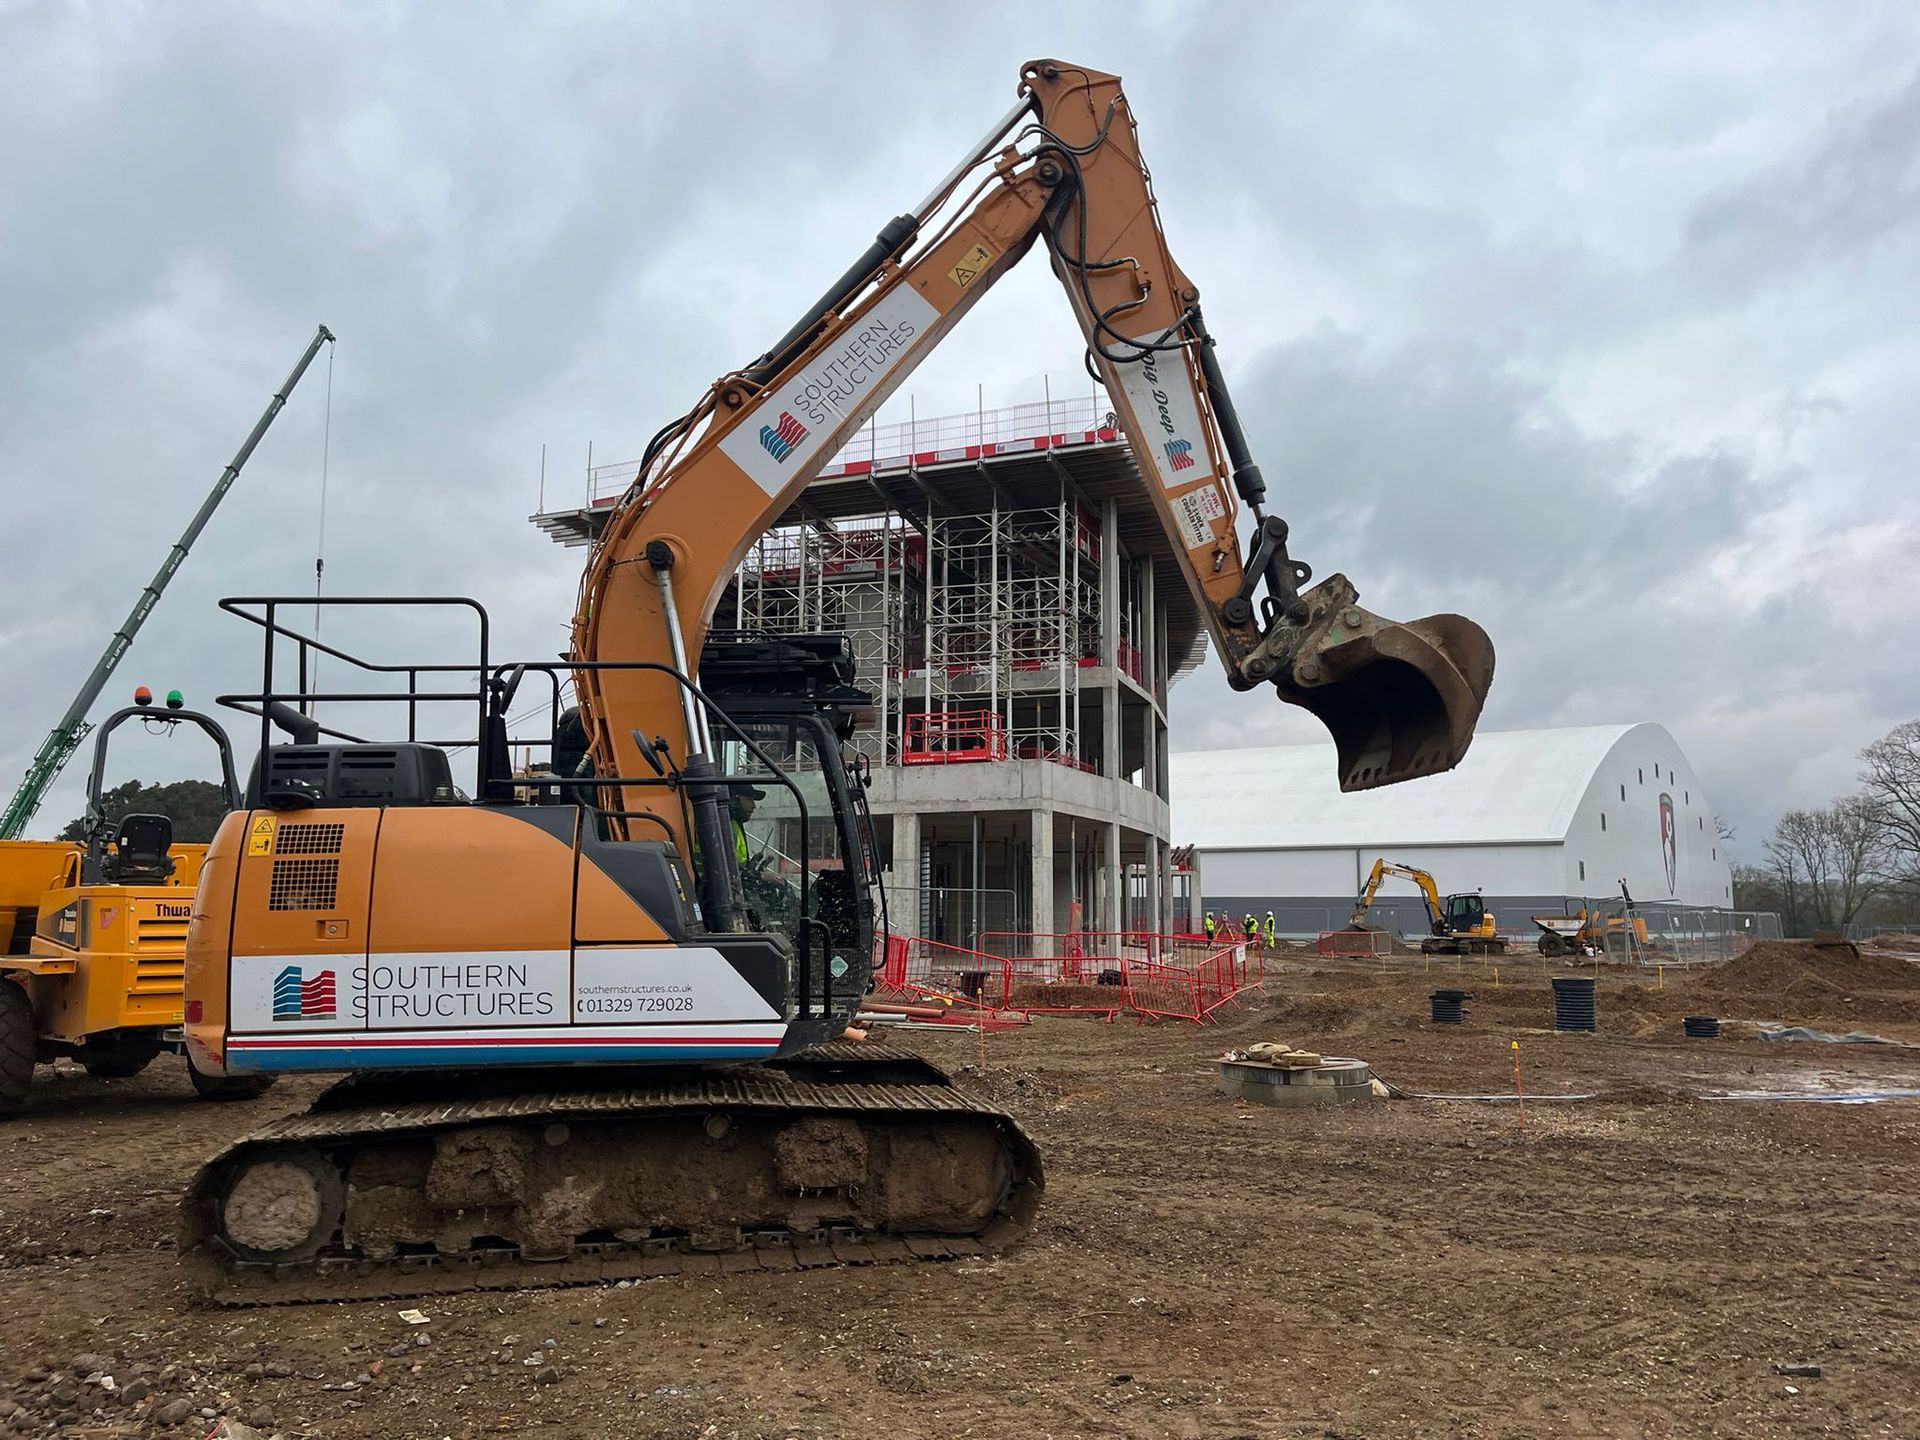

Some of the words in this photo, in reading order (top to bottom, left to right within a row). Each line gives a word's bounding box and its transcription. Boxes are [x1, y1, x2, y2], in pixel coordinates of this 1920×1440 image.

[794, 319, 888, 411] SOUTHERN
[808, 320, 915, 424] STRUCTURES
[1152, 389, 1175, 436] Deep
[1210, 492, 1220, 509] SWL
[155, 903, 193, 917] Thwa
[351, 964, 527, 990] SOUTHERN
[578, 984, 693, 995] southernstructures.co.uk
[351, 992, 553, 1018] STRUCTURES
[586, 998, 633, 1013] 01329
[637, 997, 694, 1012] 729028
